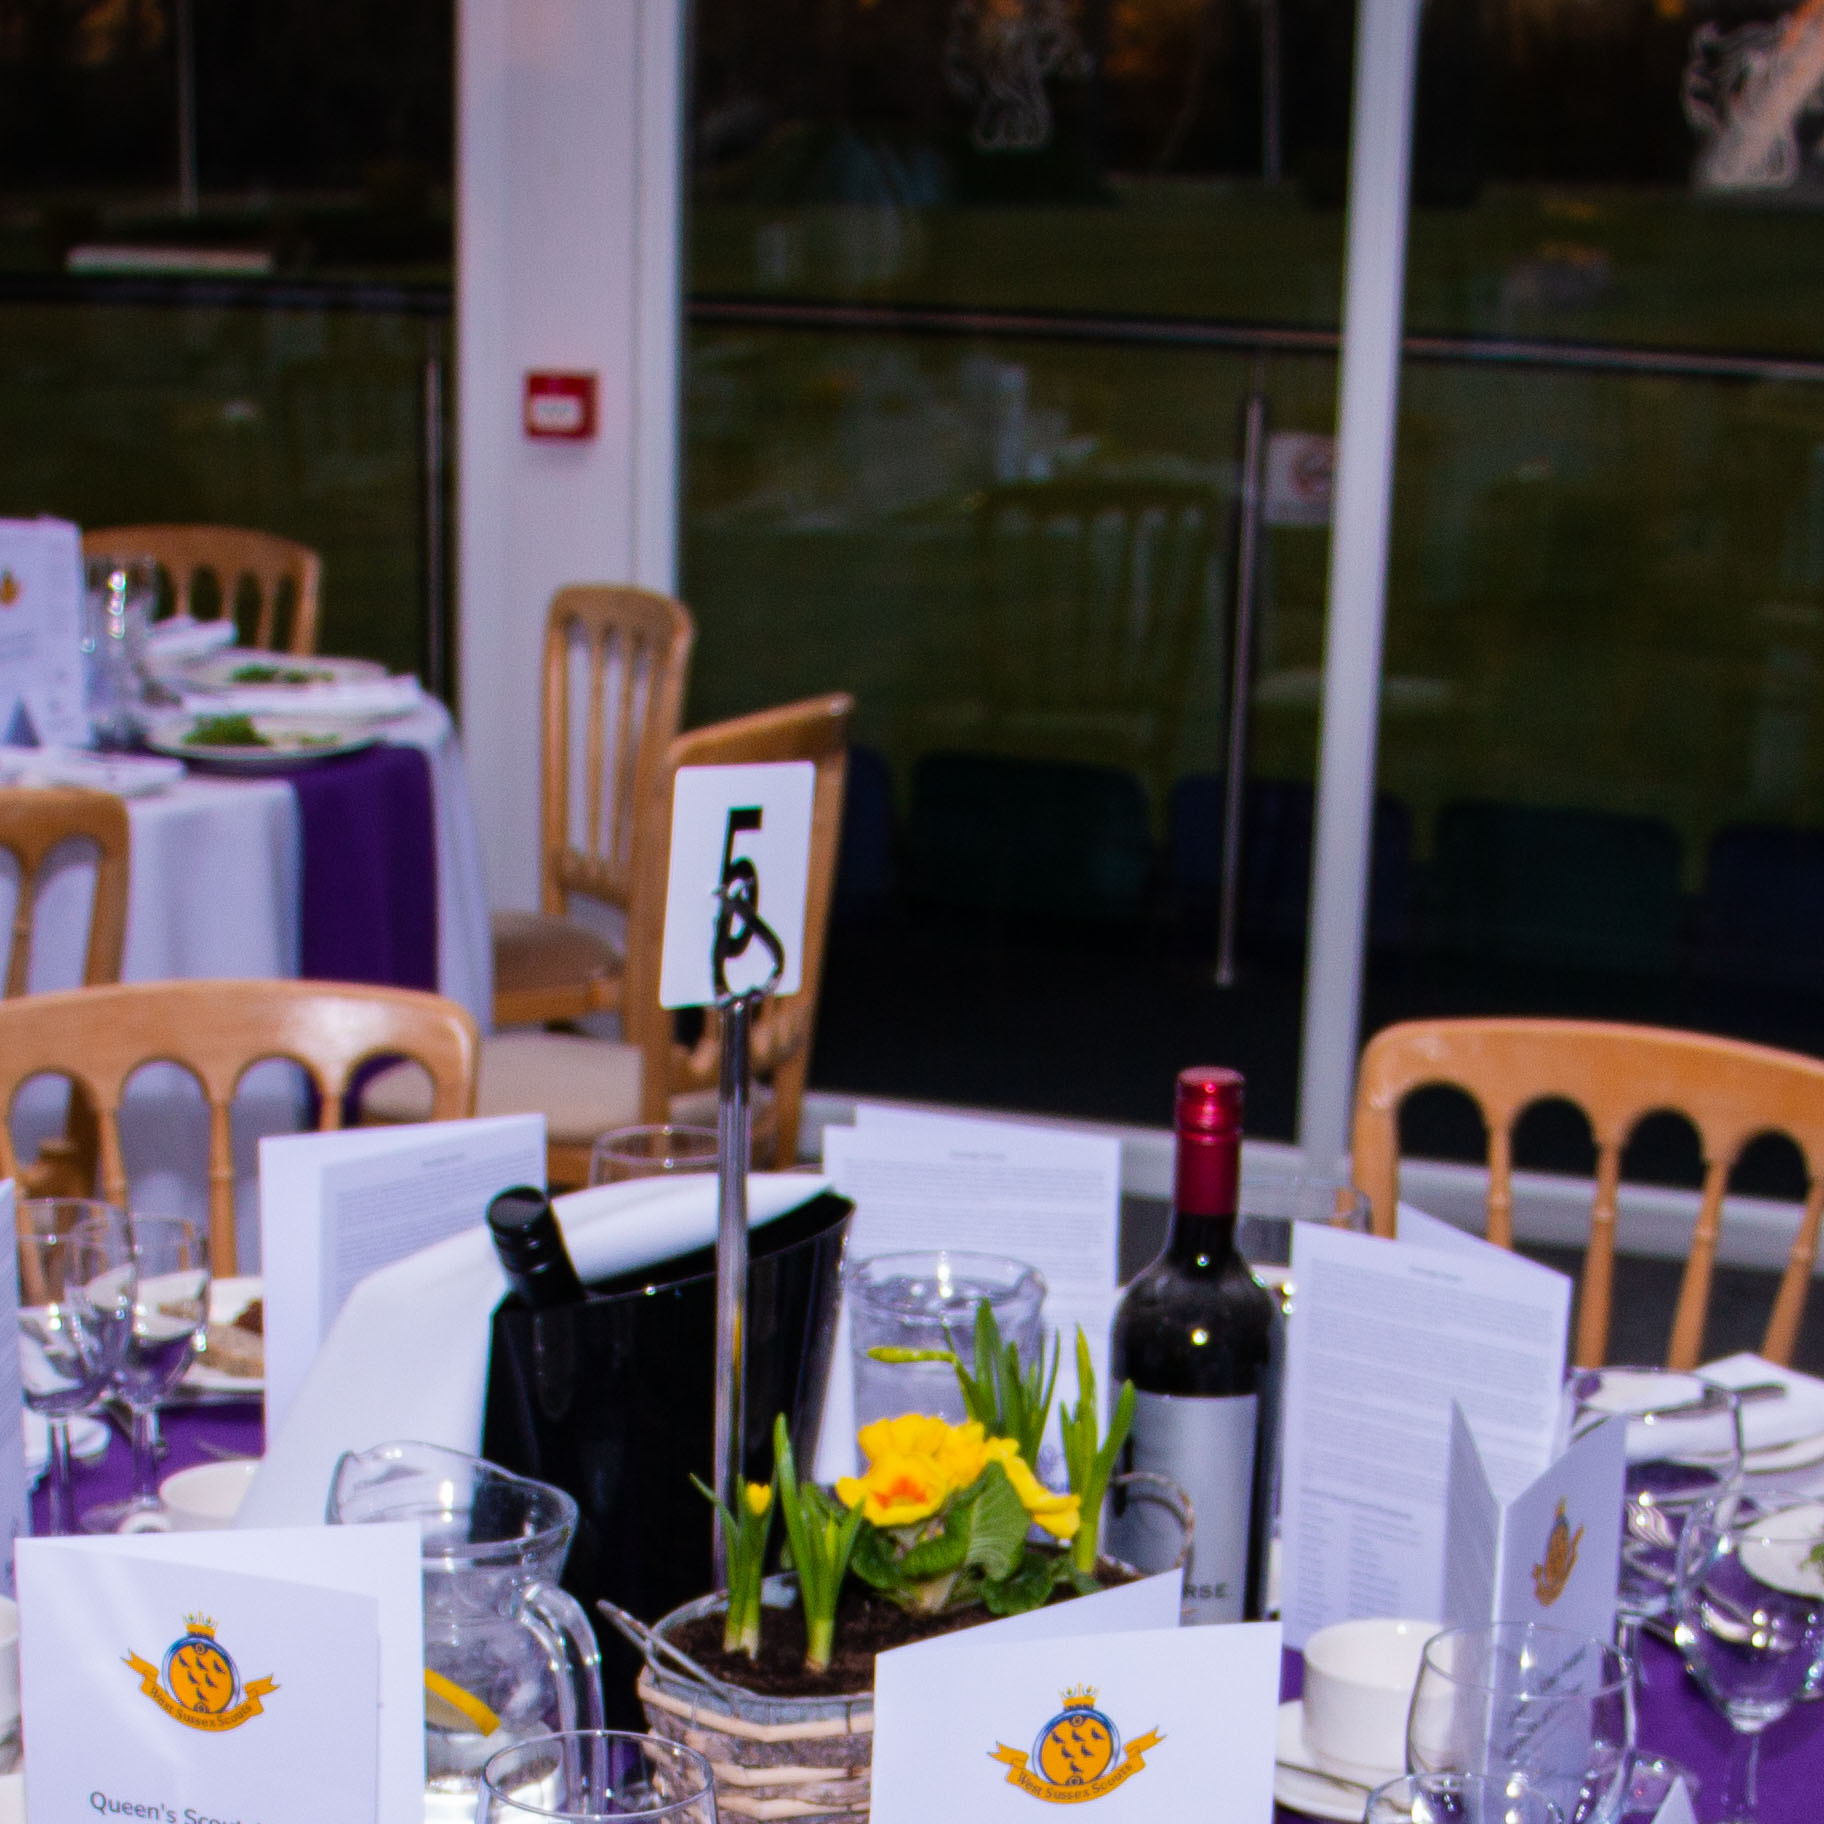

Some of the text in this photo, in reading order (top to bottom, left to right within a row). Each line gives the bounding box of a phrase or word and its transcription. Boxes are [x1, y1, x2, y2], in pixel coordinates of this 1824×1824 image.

[1184, 1582, 1229, 1599] RSE
[151, 1686, 253, 1728] West Sussex Scouts
[1018, 1764, 1133, 1800] West Sussex Scouts
[90, 1791, 177, 1824] Queen's
